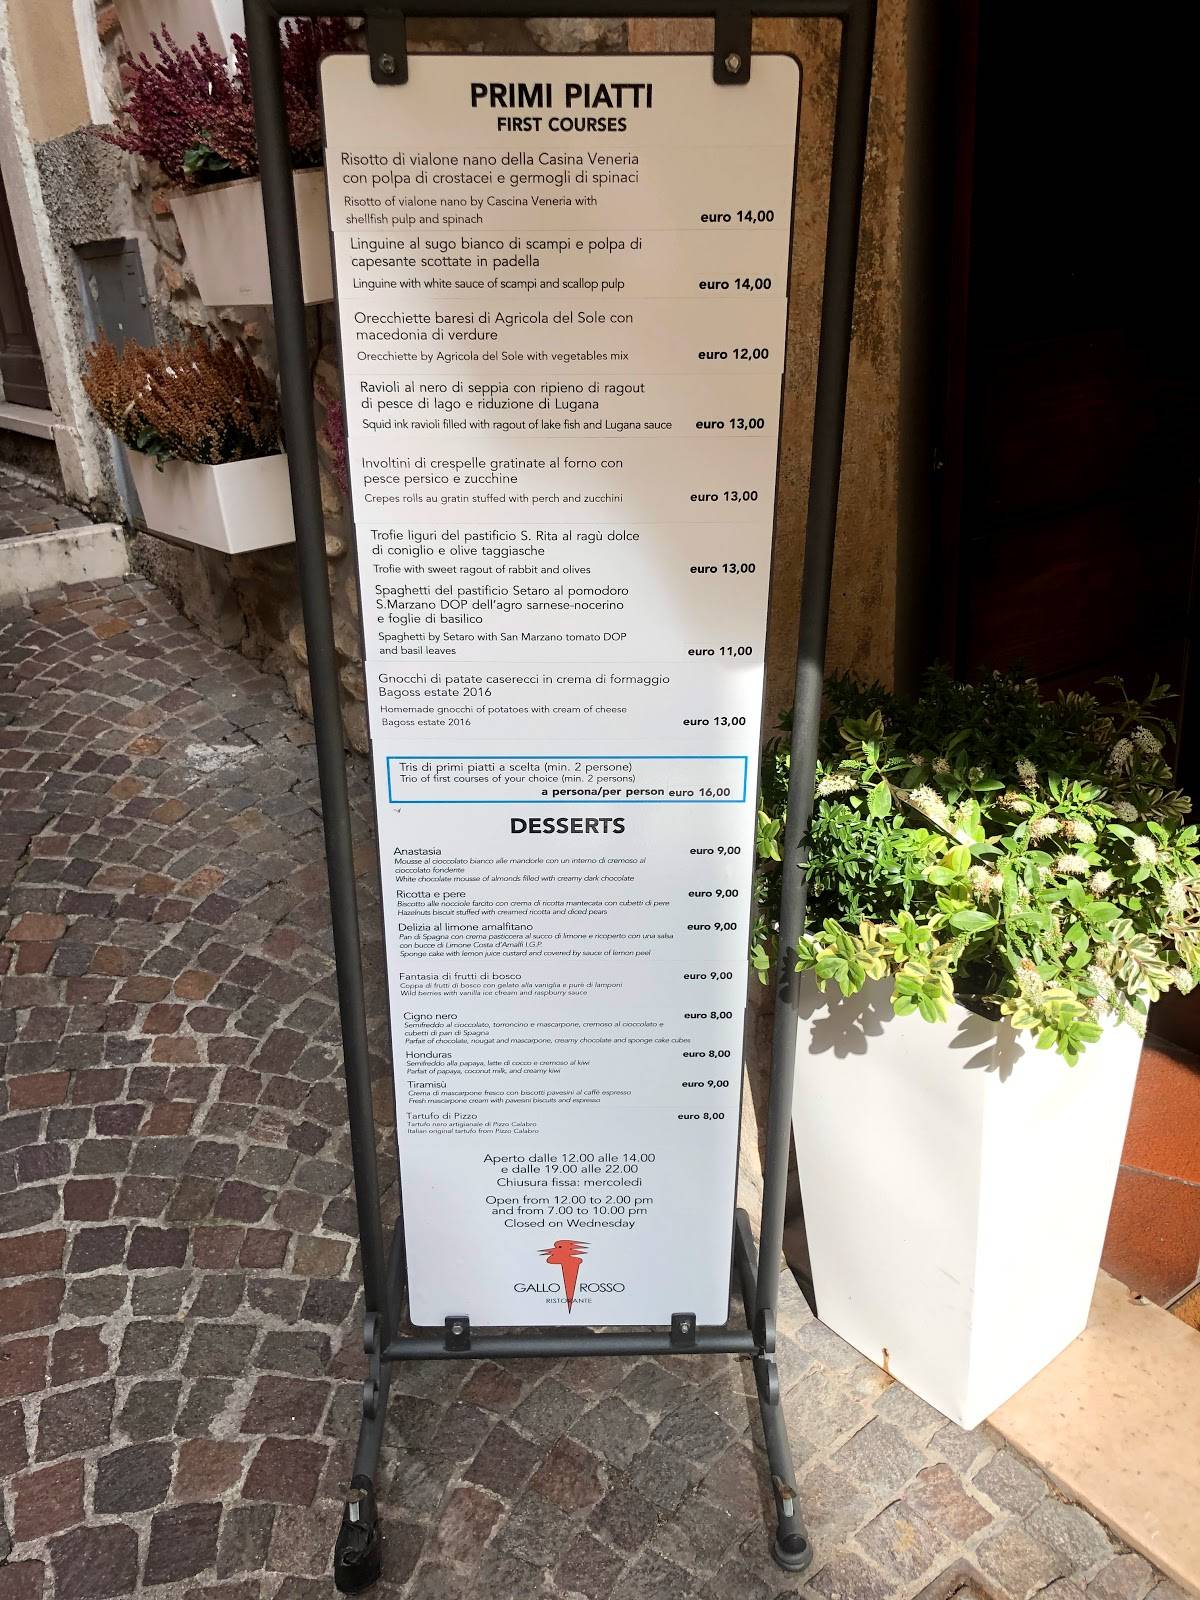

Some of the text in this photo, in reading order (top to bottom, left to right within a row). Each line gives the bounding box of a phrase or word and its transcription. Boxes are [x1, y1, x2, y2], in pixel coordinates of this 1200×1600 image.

[471, 83, 652, 108] PRIMI PIATTI
[497, 117, 627, 132] FIRST COURSES
[341, 152, 639, 167] Risotto di vialone nano della Casina Veneria
[346, 213, 483, 226] shellfish pulp and spinach
[700, 210, 774, 224] euro 14,00
[353, 278, 625, 292] Linguine with white sauce of scampi and scallop pulp
[699, 278, 772, 291] euro 14,00
[356, 328, 498, 340] macedonia di verdure
[698, 348, 769, 361] euro 12,00
[695, 418, 765, 431] euro 13,00
[364, 472, 518, 486] pesce persico e zucchine
[690, 490, 758, 503] euro 13,00
[373, 564, 591, 576] Trofie with sweet ragout of rabbit and olives
[690, 563, 756, 575] euro 13,00
[388, 613, 421, 626] foglie
[425, 613, 436, 624] di
[440, 613, 483, 624] basilico
[719, 646, 753, 657] 11,00
[379, 686, 492, 699] Bagoss estate 2016
[382, 718, 415, 728] Bagoss
[448, 718, 471, 726] 2016
[713, 716, 746, 727] 13,00
[552, 786, 622, 798] persona/per
[626, 789, 664, 798] person
[699, 788, 730, 798] 16,00
[510, 817, 625, 834] DESSERTS
[393, 847, 442, 856] Anastasia
[717, 846, 741, 856] 9,00
[395, 875, 417, 883] White
[417, 875, 452, 883] chocolate
[396, 890, 431, 898] Ricotta
[443, 891, 466, 900] pere
[715, 889, 739, 899] 9,00
[398, 922, 533, 931] Delizia al limone amalfitano
[714, 922, 737, 932] 9,00
[399, 972, 522, 981] Fantasia di frutti di bosco
[710, 971, 733, 981] 9,00
[403, 1011, 433, 1021] Cigno
[710, 1011, 733, 1020] 8,00
[406, 1051, 452, 1059] Honduras
[708, 1050, 731, 1059] 8,00
[407, 1081, 447, 1089] Tiramisù
[707, 1080, 729, 1088] 9,00
[406, 1112, 478, 1120] Tartufo di Pizzo
[703, 1112, 725, 1120] 8,00
[483, 1153, 656, 1164] Aperto dalle 12.00 alle 14.00
[511, 1164, 541, 1174] dalle
[545, 1164, 578, 1174] 19.00
[581, 1164, 601, 1173] alle
[605, 1164, 638, 1173] 22.00
[497, 1177, 548, 1187] Chiusura
[552, 1177, 580, 1187] fissa:
[485, 1195, 653, 1206] Open from 12.00 to 2.00 pm
[492, 1206, 647, 1216] and from 7.00 to 10.00 pm
[504, 1219, 545, 1228] Closed
[566, 1219, 635, 1230] Wednesday
[513, 1282, 625, 1293] GALLO ROSSO
